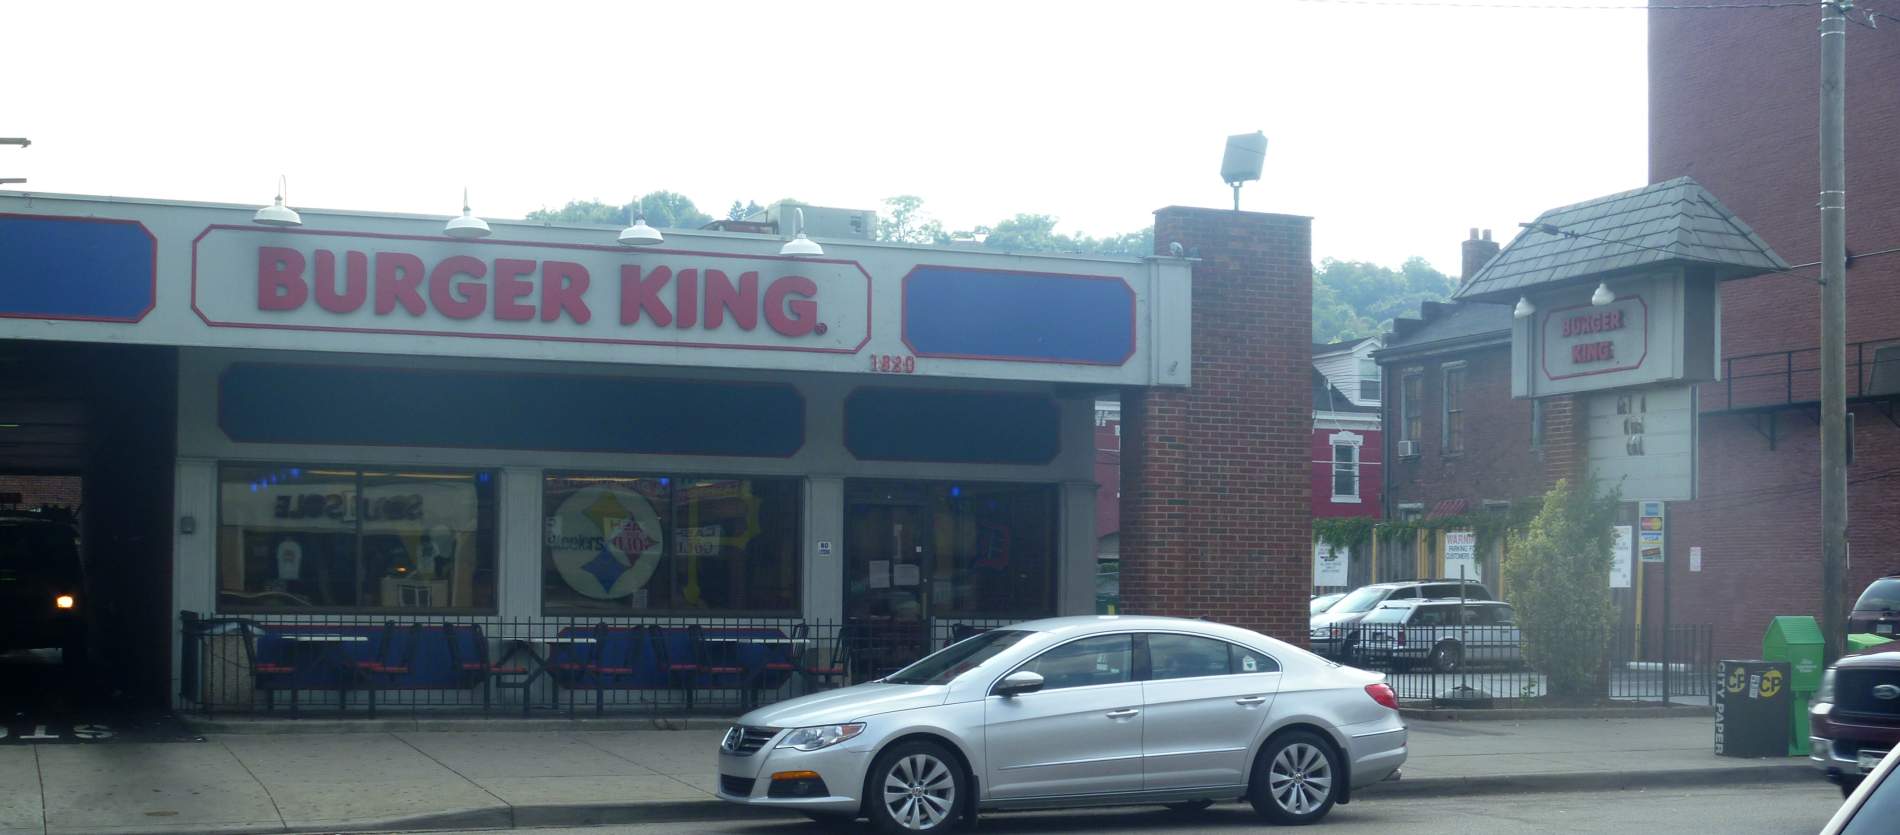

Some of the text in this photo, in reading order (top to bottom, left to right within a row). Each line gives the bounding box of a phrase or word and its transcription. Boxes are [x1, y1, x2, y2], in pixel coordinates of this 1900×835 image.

[257, 246, 818, 337] BURGER KING
[1562, 310, 1624, 337] BURGER
[870, 352, 914, 373] 1820
[1572, 341, 1613, 363] KING
[1717, 662, 1726, 698] CITY
[1760, 675, 1783, 693] CP
[1714, 703, 1725, 754] PAPER
